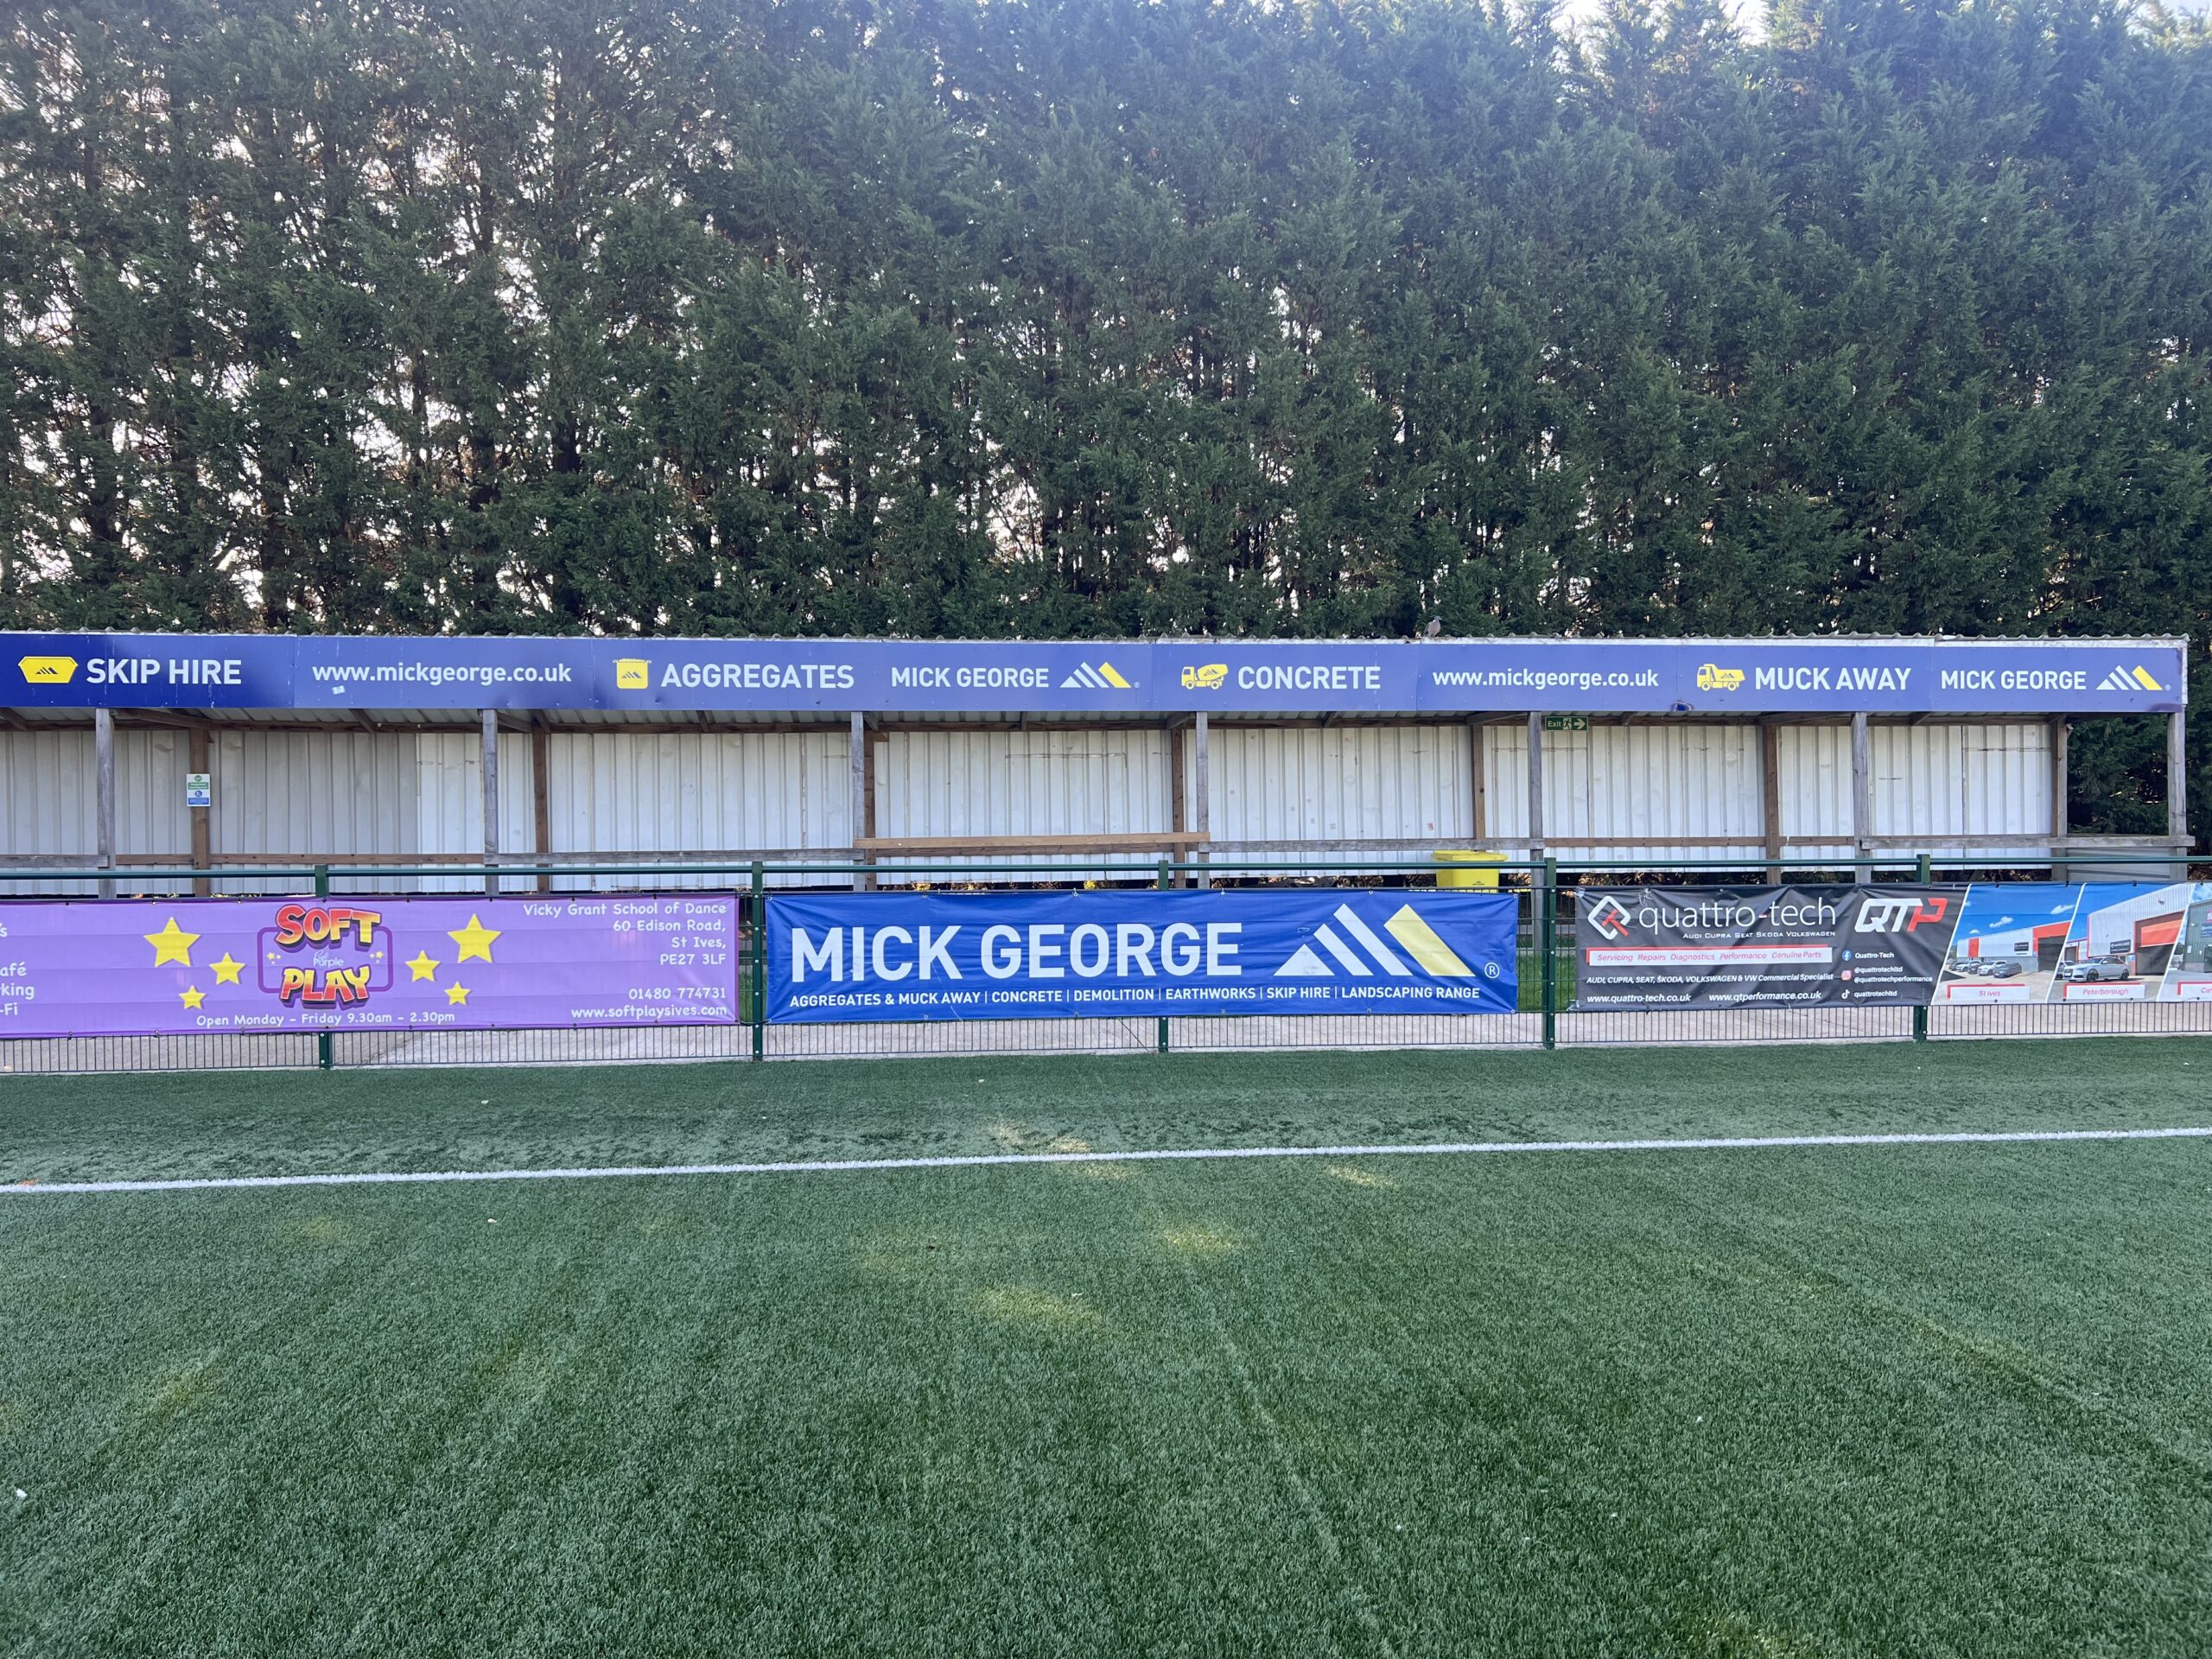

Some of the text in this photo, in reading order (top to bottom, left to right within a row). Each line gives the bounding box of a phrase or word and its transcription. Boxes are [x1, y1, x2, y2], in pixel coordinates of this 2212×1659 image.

[86, 658, 242, 684] SKIP HIRE
[312, 662, 572, 686] www.mickgeorge.co.uk
[661, 663, 855, 690] AGGREGATES
[892, 667, 1049, 689] MICK GEORGE
[1237, 665, 1382, 690] CONCRETE
[1433, 668, 1659, 690] www.mickgeorge.co.uk
[1756, 667, 1911, 690] MUCK AWAY
[1942, 670, 2087, 690] MICK GEORGE
[524, 902, 727, 918] Vicky Grant School of Dance
[1638, 896, 1835, 935] quattro-tech
[1854, 898, 1948, 932] QTP
[276, 905, 381, 944] SOFT
[613, 919, 726, 932] 60 Edison Road,
[671, 937, 726, 949] St Ives,
[791, 922, 1242, 982] MICK GEORGE
[313, 957, 344, 967] Purple
[660, 953, 726, 965] PE27 3LF
[280, 965, 371, 1002] PLAY
[1800, 973, 1834, 982] Specialist
[0, 982, 35, 1000] king
[629, 988, 726, 1000] 01480 774731
[790, 994, 881, 1007] AGGREGATES
[885, 993, 895, 1005] &
[899, 992, 938, 1005] MUCK
[941, 992, 981, 1004] AWAY
[992, 990, 1063, 1003] CONCRETE
[1074, 988, 1154, 1002] DEMOLITION
[1166, 988, 1255, 1000] EARTHWORKS
[1267, 987, 1297, 999] SKIP
[1300, 987, 1331, 999] HIRE
[1342, 987, 1432, 998] LANDSCAPING
[1436, 987, 1479, 998] RANGE
[1587, 994, 1692, 1004] www.quattro-tech.co.uk
[1709, 991, 1821, 1002] www.qtperformance.co.uk
[196, 1015, 229, 1028] Open
[234, 1014, 284, 1026] Monday
[302, 1013, 342, 1026] Friday
[347, 1014, 391, 1023] 9.30am
[410, 1012, 454, 1024] 2.30pm
[571, 1004, 727, 1020] www.softplaysives.com
